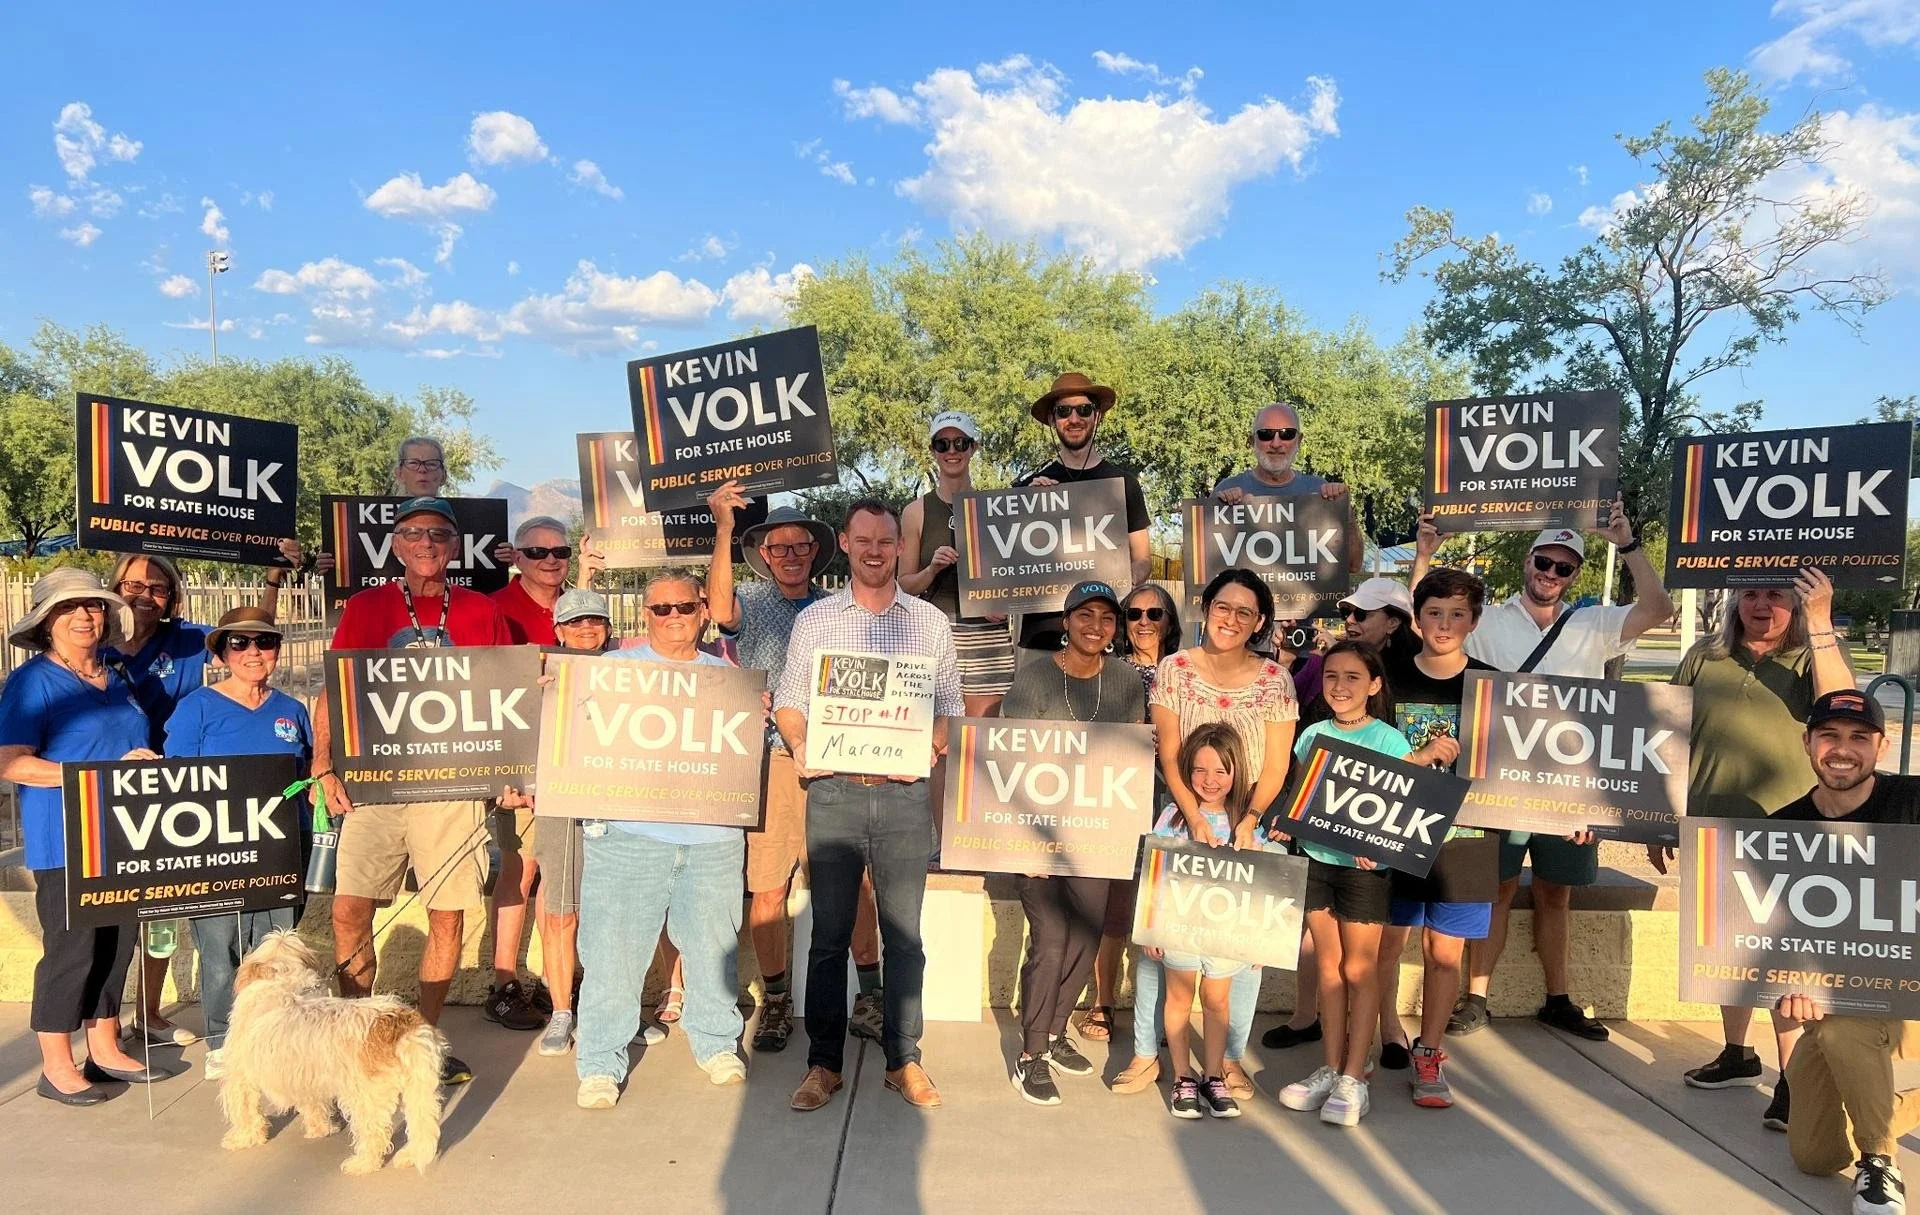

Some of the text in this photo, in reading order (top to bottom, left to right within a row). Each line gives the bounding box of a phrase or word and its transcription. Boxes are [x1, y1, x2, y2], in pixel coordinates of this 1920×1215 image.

[665, 347, 758, 387] KEVIN
[667, 372, 816, 438] VOLK
[1461, 401, 1554, 427] KEVIN
[123, 408, 230, 446] KEVIN
[675, 430, 792, 460] FOR STATE HOUSE
[1459, 428, 1604, 473] VOLK
[1716, 437, 1829, 469] KEVIN
[121, 441, 283, 504] VOLK
[651, 473, 696, 490] PUBLIC
[700, 464, 752, 483] SERVICE
[754, 460, 783, 473] OVER
[786, 452, 832, 468] POLITICS
[1460, 477, 1577, 492] FOR STATE HOUSE
[1713, 470, 1893, 521] VOLK
[124, 494, 255, 520] FOR STATE HOUSE
[987, 491, 1069, 516] KEVIN
[1214, 503, 1294, 525] KEVIN
[1432, 498, 1612, 515] PUBLIC SERVICE OVER POLITICS
[90, 517, 284, 546] PUBLIC SERVICE OVER POLITIC
[622, 514, 716, 526] FOR STATE HOU
[595, 536, 716, 550] PUBLIC SERVICE OVE
[987, 514, 1117, 559] VOLK
[1213, 529, 1339, 566] VOLK
[1711, 528, 1855, 542] FOR STATE HOUSE
[358, 532, 496, 569] VK
[1676, 554, 1900, 569] PUBLIC SERVICE OVER POLITICS
[992, 560, 1095, 576] FOR STATE HOUSE
[1278, 572, 1316, 582] HOUSE
[362, 577, 387, 586] FOR
[446, 577, 472, 586] USE
[968, 589, 1008, 600] PUBLIC
[1013, 585, 1058, 598] SERVICE
[1081, 584, 1112, 595] VOTE
[1282, 593, 1306, 601] OVER
[1309, 592, 1346, 600] POLITICS
[367, 656, 471, 682] KEVIN
[834, 657, 866, 669] KEVIN
[896, 662, 927, 670] DRIVE
[896, 672, 932, 680] ACROSS
[589, 665, 697, 698] KEVIN
[832, 669, 885, 691] VOLK
[842, 688, 860, 696] STATE
[861, 689, 881, 698] HOUSE
[904, 680, 923, 688] THE
[891, 690, 933, 699] DISTRICT
[1506, 682, 1616, 715] KEVIN
[367, 688, 530, 735] VOLK
[824, 705, 872, 723] STOP
[586, 700, 750, 755] VOLK
[988, 727, 1087, 754] KEVIN
[372, 740, 502, 756] FOR STATE HOUSE
[822, 733, 903, 759] Marana
[1502, 715, 1673, 775] VOLK
[344, 764, 536, 782] PUBLIC SERVICE OVER POLITIC
[583, 755, 719, 775] FOR STATE HOUSE
[1332, 755, 1415, 796] KEVIN
[113, 765, 227, 796] KEVIN
[548, 782, 755, 803] PUBLIC SERVICE OVER POLITICS
[986, 760, 1139, 810] VOLK
[1500, 768, 1638, 793] FOR STATE HOUSE
[984, 812, 1109, 830] FOR STATE HOUSE
[1324, 779, 1446, 846] VOLK
[1465, 792, 1680, 824] PUBLIC SERVICE OVER POLITICS
[112, 796, 286, 851] VOLK
[1309, 815, 1405, 852] FOR STATE HOUSE
[314, 834, 334, 845] ETI
[952, 836, 1002, 849] PUBLIC
[1007, 839, 1064, 853] SERVICE
[1735, 830, 1875, 865] KEVIN
[116, 851, 258, 875] FOR STATE HOUSE
[1172, 853, 1254, 884] KEVIN
[80, 889, 140, 907] PUBLIC
[144, 882, 209, 900] SERVICE
[212, 880, 245, 892] OVER
[249, 874, 297, 888] POLITICS
[1170, 879, 1295, 930] VOLK
[1734, 935, 1912, 960] FOR STATE HOUSE
[1693, 964, 1759, 981] PUBLIC
[1765, 969, 1845, 988] SERVICE
[1849, 976, 1892, 990] OVER
